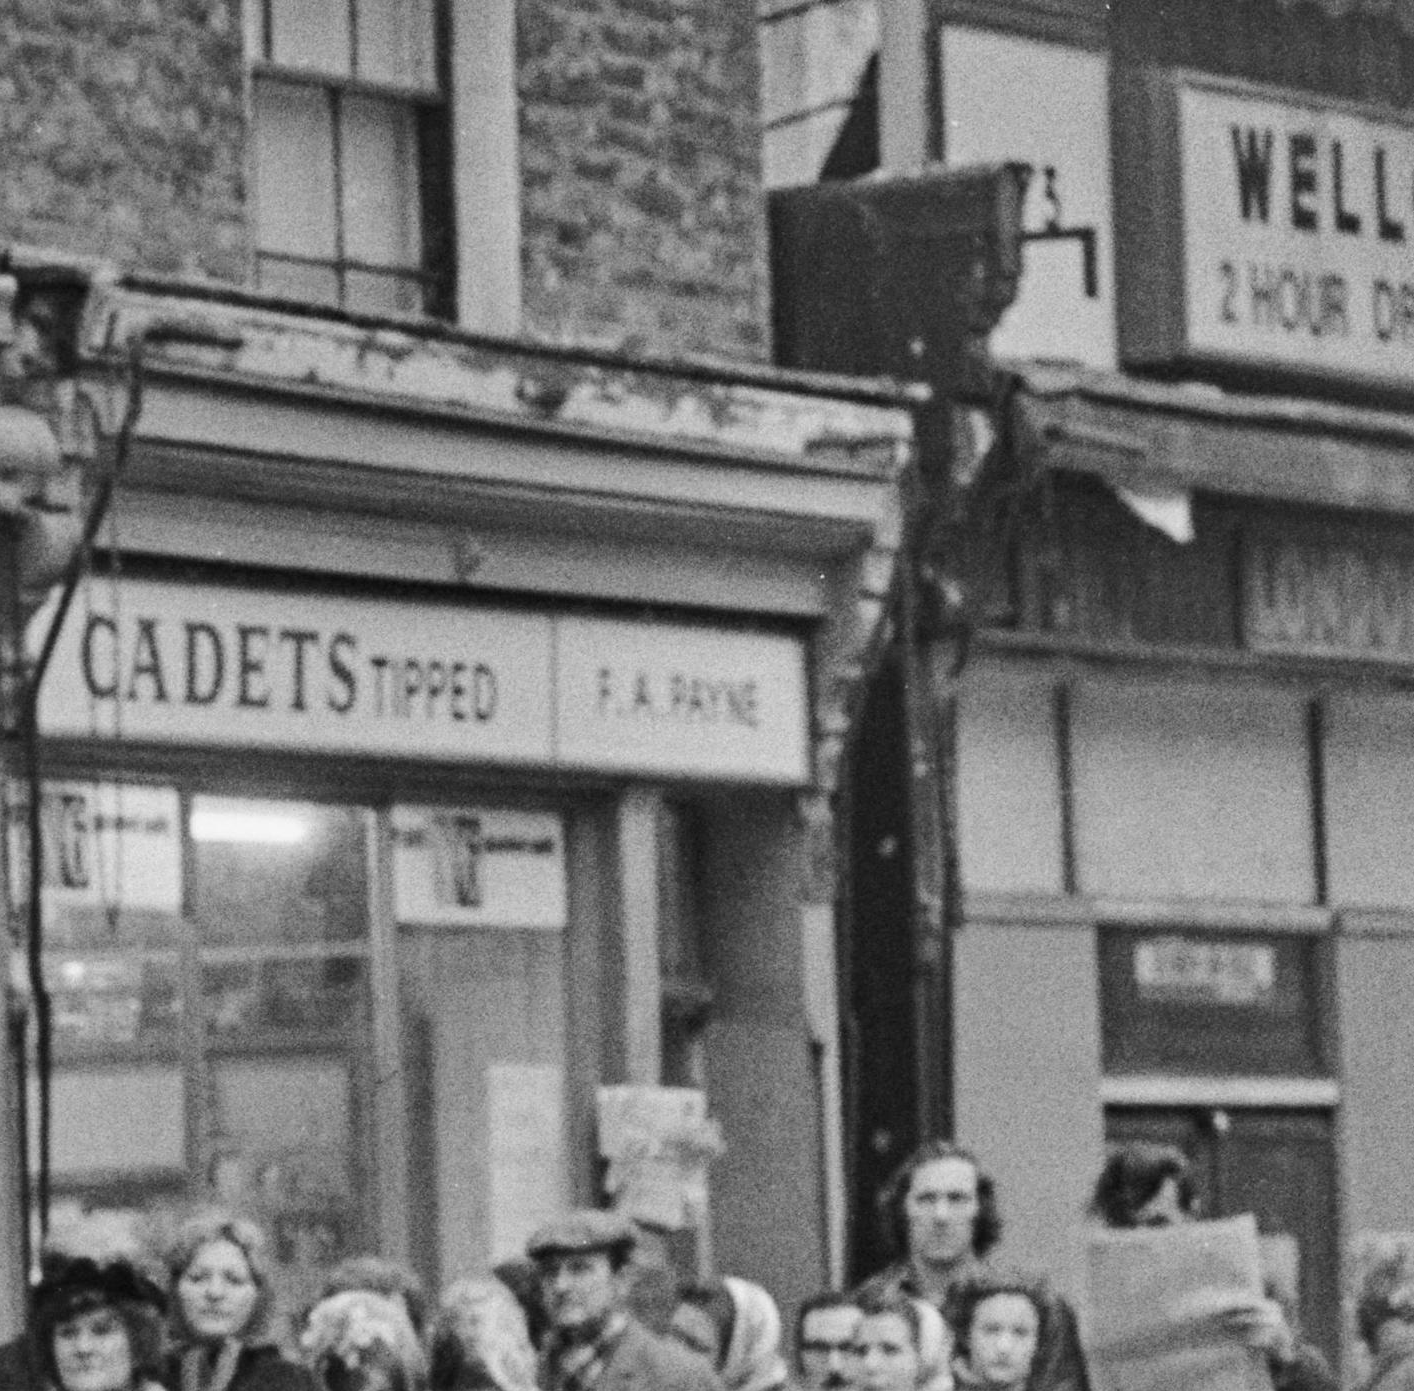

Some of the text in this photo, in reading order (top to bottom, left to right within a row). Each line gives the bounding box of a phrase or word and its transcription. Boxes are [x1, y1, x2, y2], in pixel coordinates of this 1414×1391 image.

[1229, 122, 1414, 243] WELL
[1247, 262, 1349, 338] HOUR
[80, 612, 499, 724] CADETS TIPPED
[670, 672, 760, 731] PAYNE
